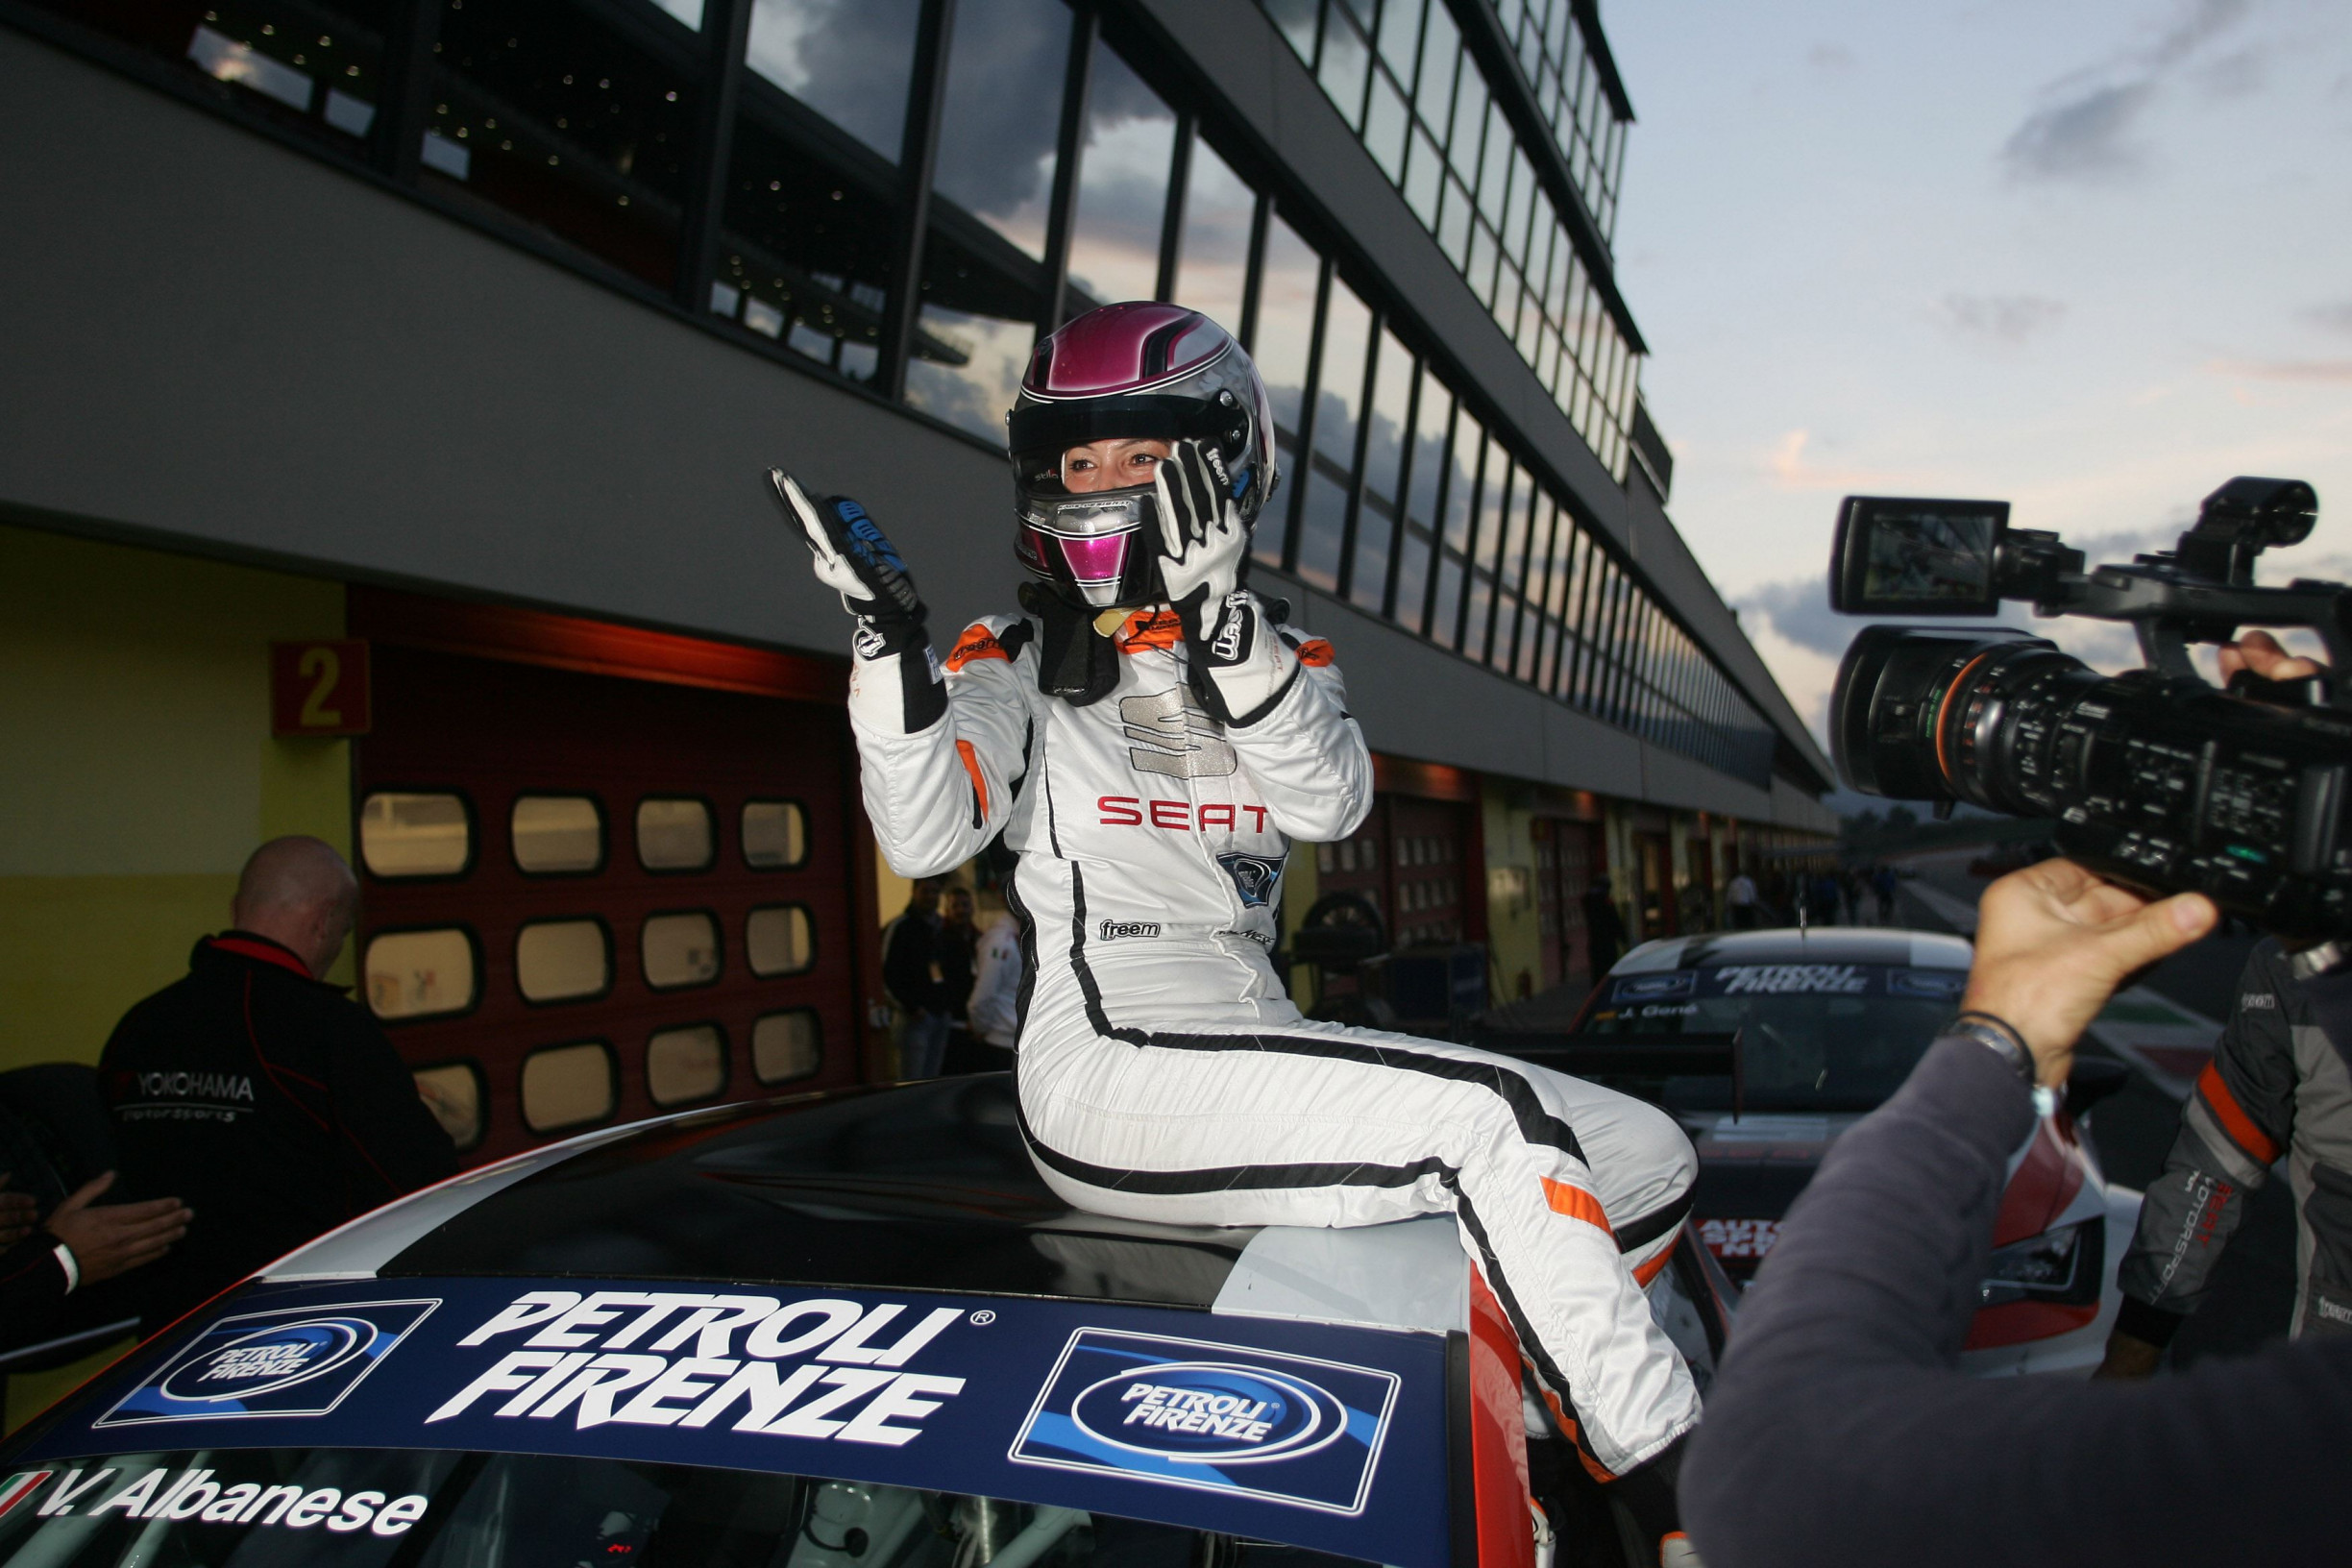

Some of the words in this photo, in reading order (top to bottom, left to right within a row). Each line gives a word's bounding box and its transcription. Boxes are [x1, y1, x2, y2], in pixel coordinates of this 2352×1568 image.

[298, 647, 342, 728] 2
[1097, 796, 1269, 834] SEAT
[1101, 919, 1162, 942] freem
[1725, 977, 1868, 994] FIRENZE
[136, 1071, 255, 1102] YOKOHAMA
[455, 1290, 965, 1369] PETROLI
[196, 1358, 310, 1383] FIRENZE
[208, 1342, 319, 1365] PETROLI
[424, 1351, 966, 1446] FIRENZE
[1120, 1383, 1267, 1420] PETROLI
[1122, 1403, 1273, 1442] FIRENZE
[37, 1468, 117, 1517] V.
[92, 1468, 429, 1535] Albanese
